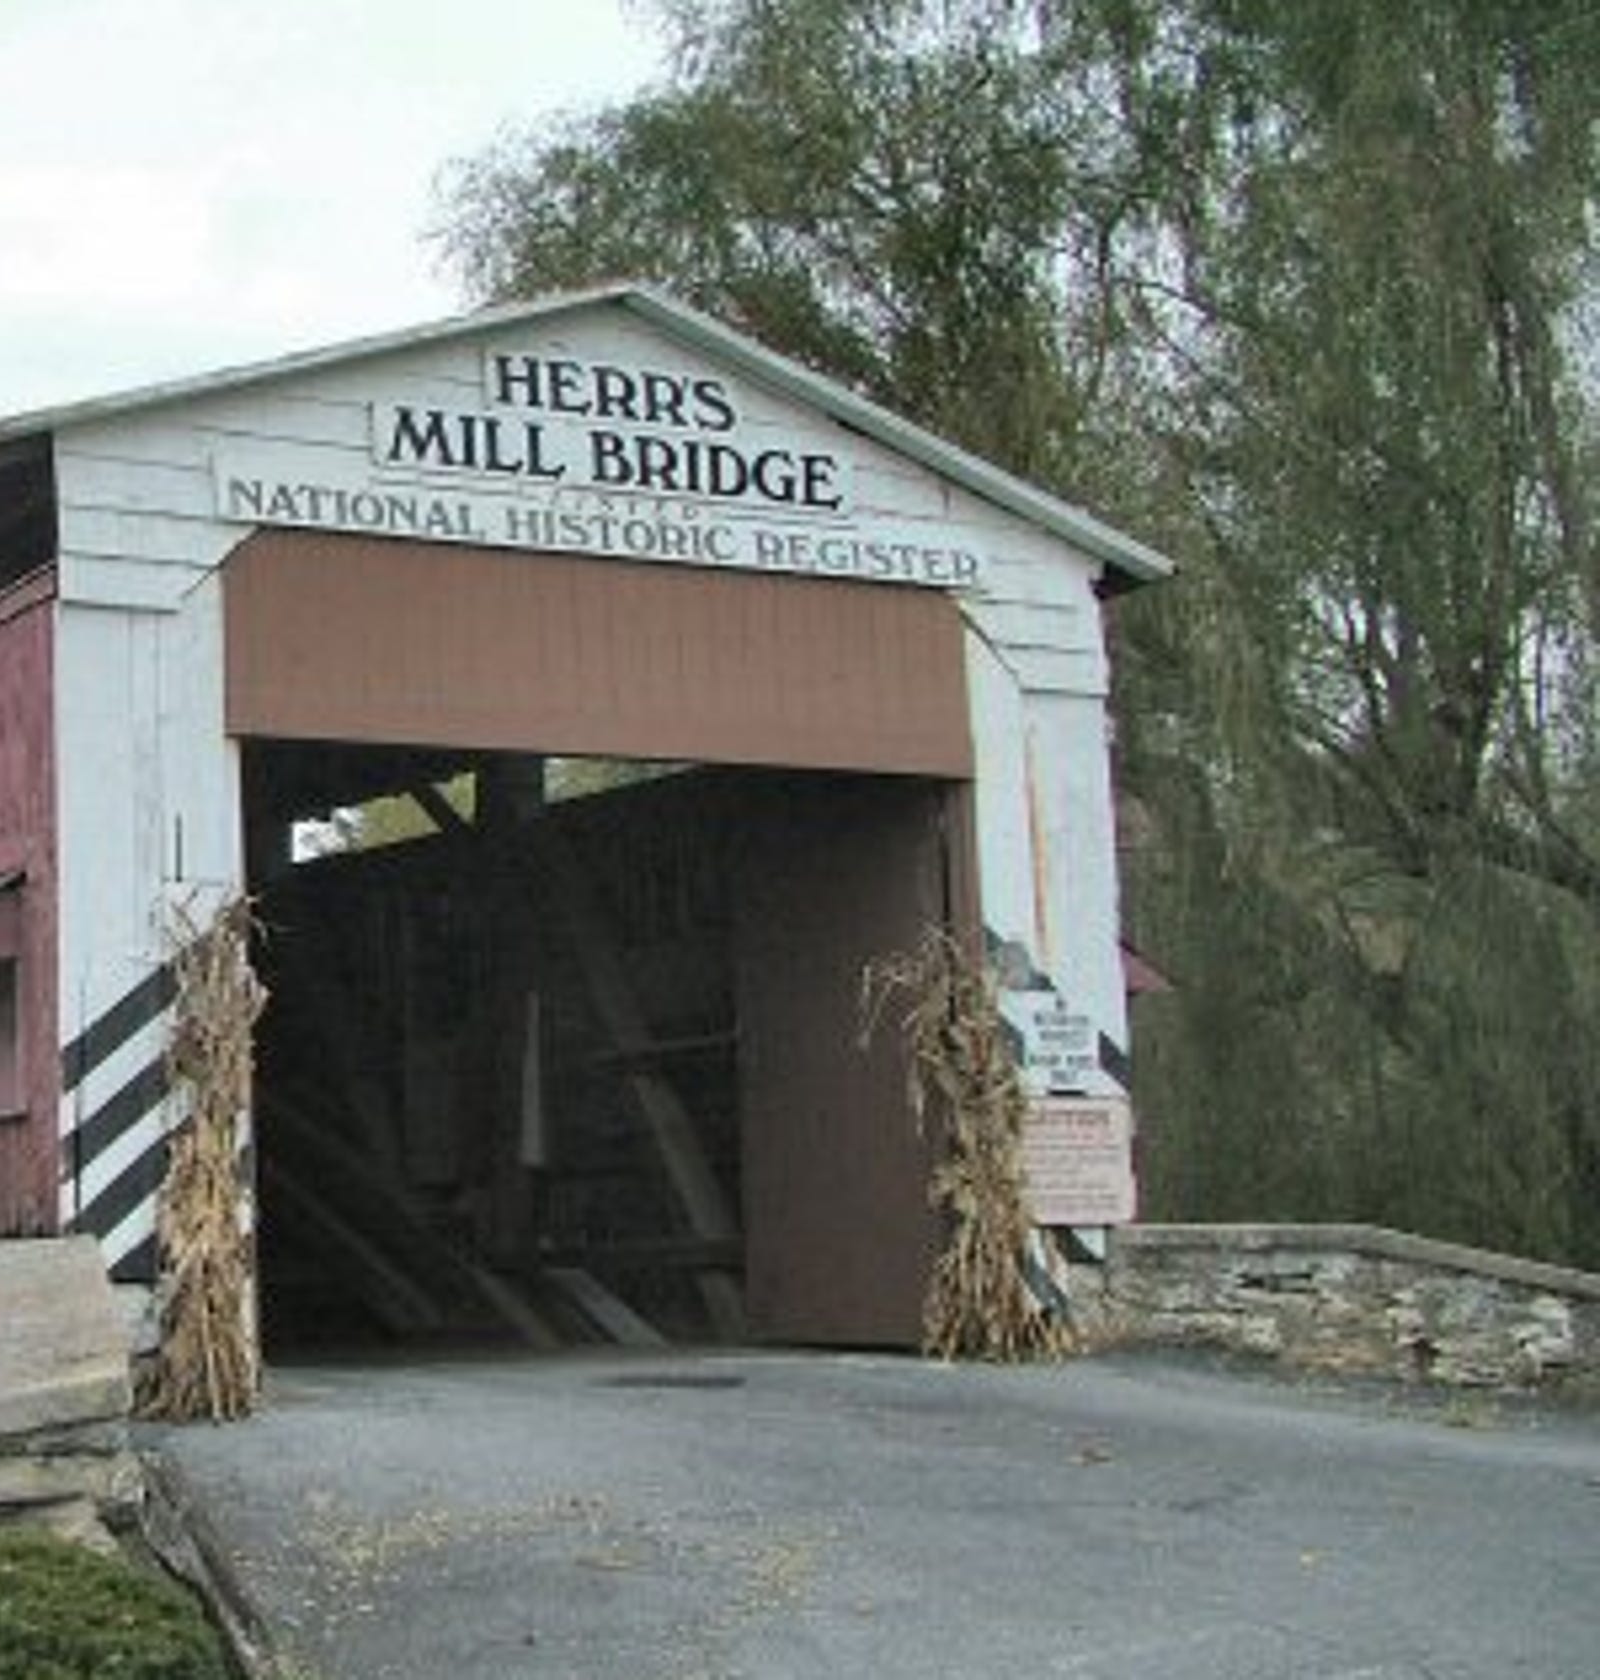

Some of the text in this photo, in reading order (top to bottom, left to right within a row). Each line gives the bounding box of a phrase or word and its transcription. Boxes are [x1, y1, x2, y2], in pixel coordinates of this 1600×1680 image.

[496, 354, 736, 432] HERR'S
[387, 406, 842, 510] MILL BRIDGE
[229, 478, 979, 582] NATIONAL HISTORIC REGISTER
